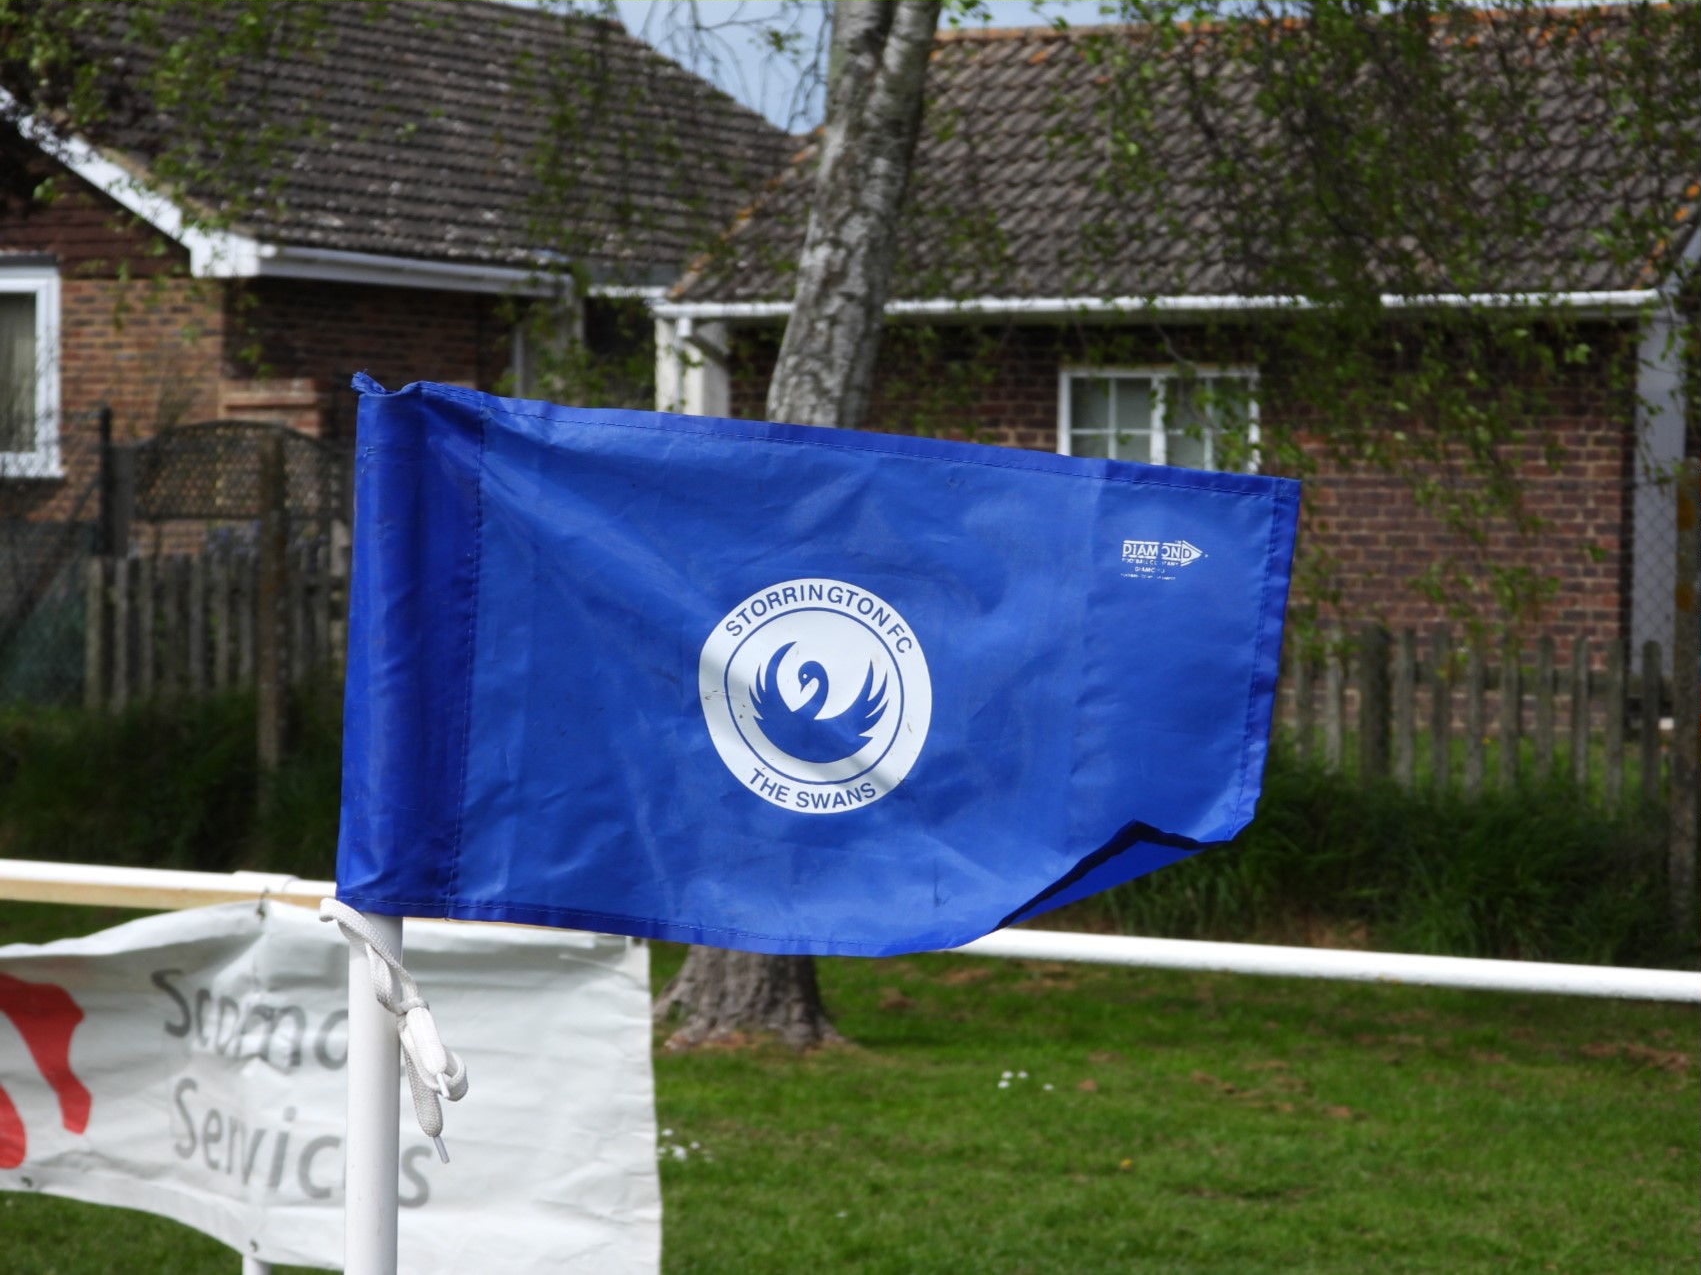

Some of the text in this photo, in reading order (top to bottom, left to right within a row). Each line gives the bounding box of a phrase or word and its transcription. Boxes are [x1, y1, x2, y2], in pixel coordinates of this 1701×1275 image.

[725, 584, 913, 655] STORRINGTON FC
[749, 768, 877, 809] THE SWANS
[172, 1077, 433, 1209] Servics
